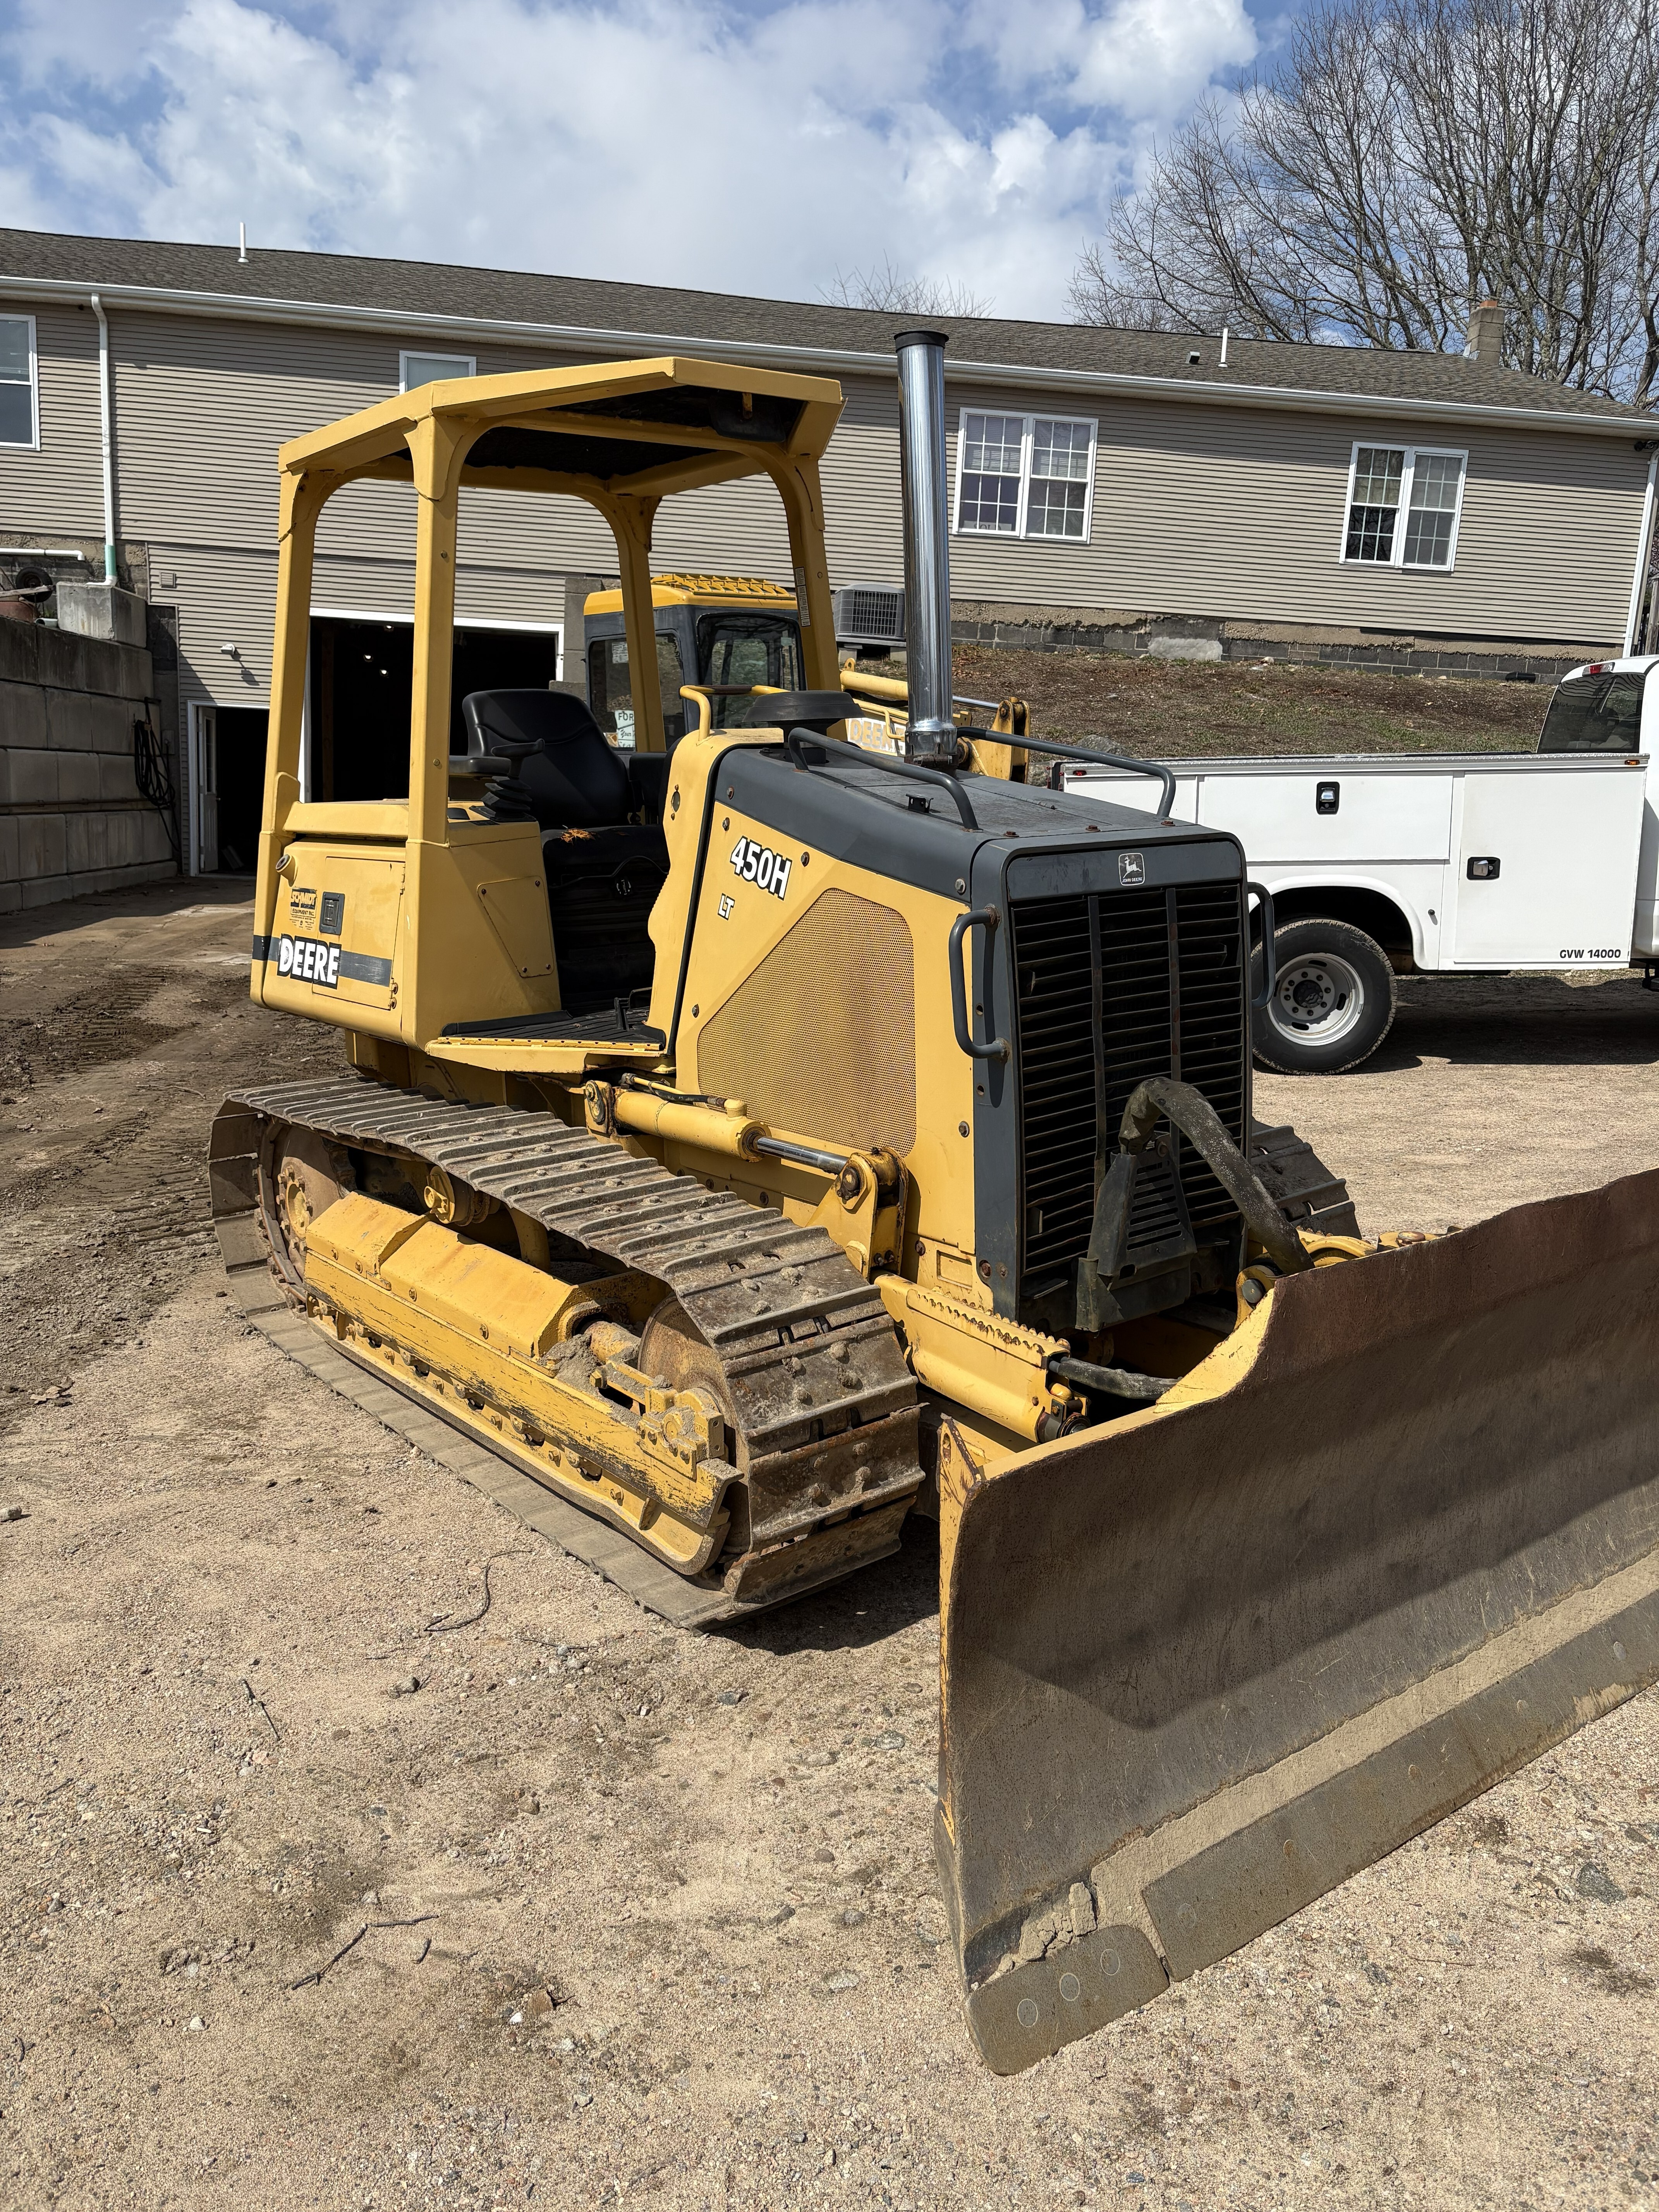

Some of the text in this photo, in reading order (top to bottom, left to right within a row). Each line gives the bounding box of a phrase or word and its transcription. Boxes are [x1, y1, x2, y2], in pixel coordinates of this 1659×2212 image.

[618, 713, 634, 721] FOR
[730, 837, 792, 899] 450H
[290, 891, 317, 908] SCHMIDT
[718, 895, 735, 919] LT
[279, 937, 340, 985] DEERE
[1559, 949, 1621, 958] GVW 14000
